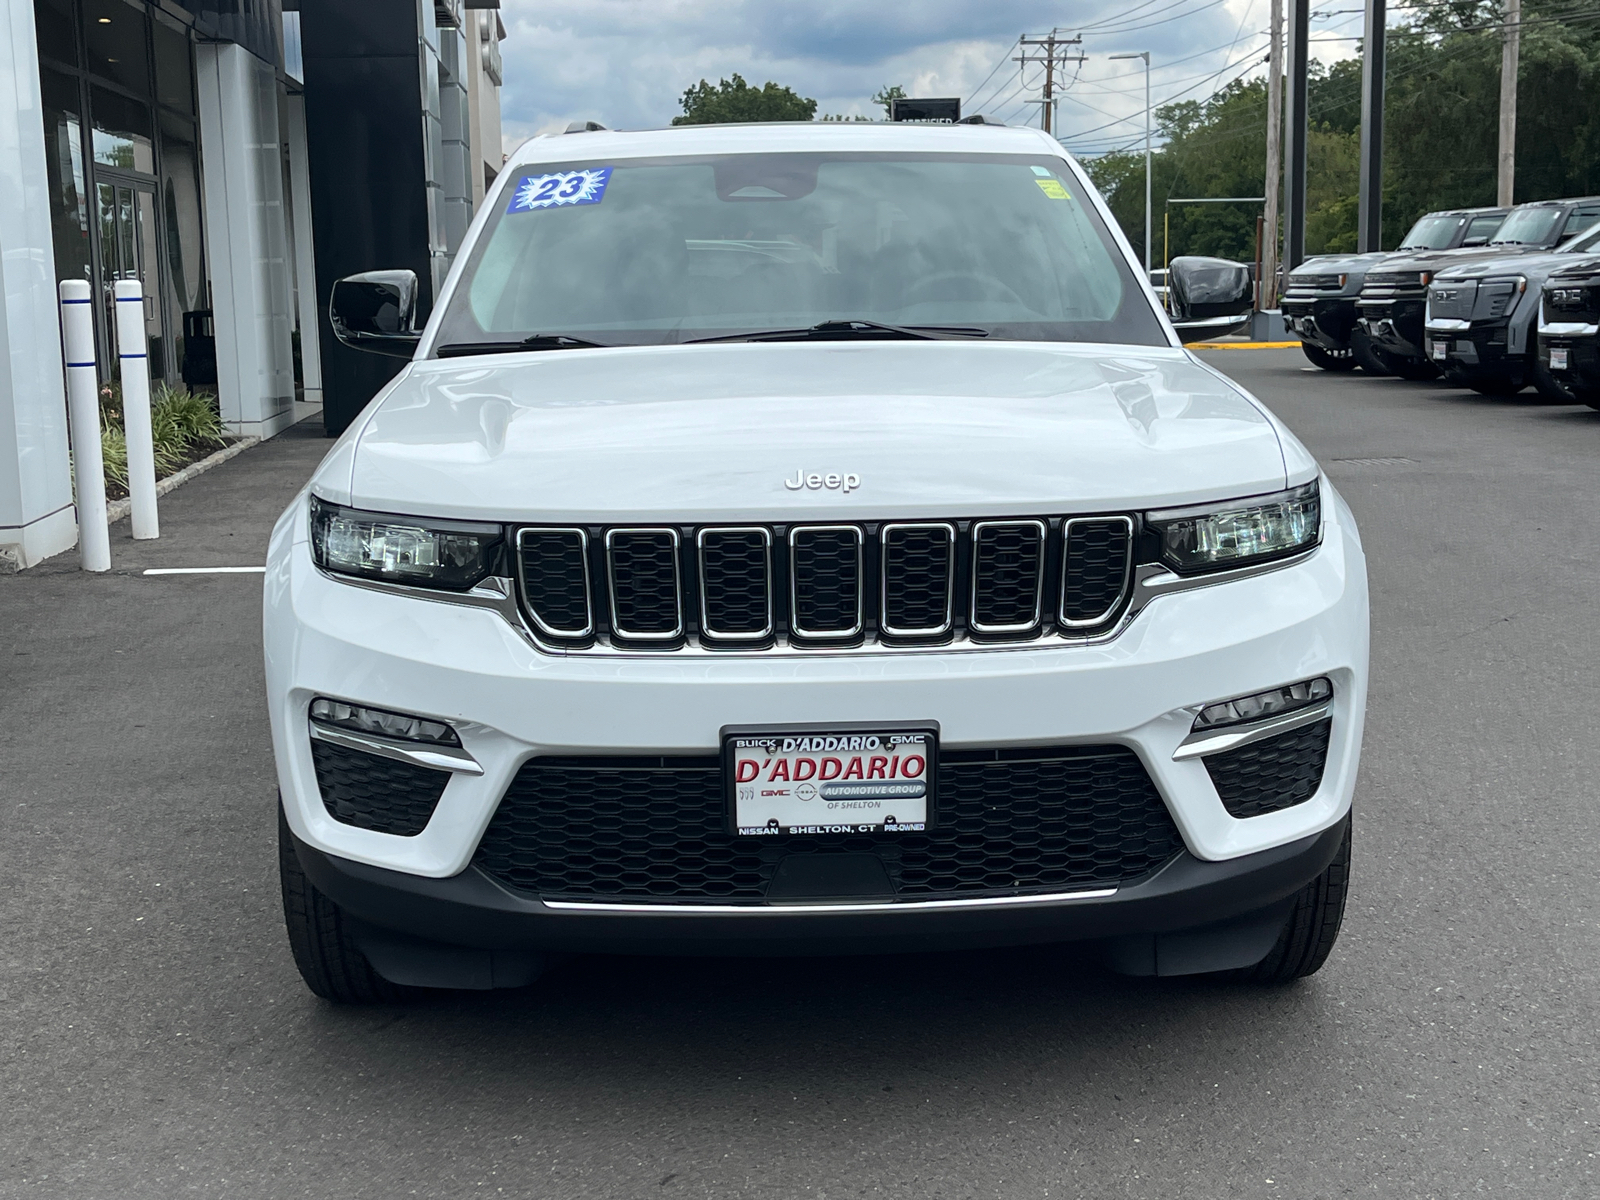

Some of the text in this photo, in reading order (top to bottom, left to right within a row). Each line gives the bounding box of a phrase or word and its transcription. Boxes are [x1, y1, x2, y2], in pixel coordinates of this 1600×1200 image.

[532, 176, 586, 201] 23
[784, 469, 861, 494] Jeep
[736, 735, 925, 753] BUICK D'ADDARIO GMC
[736, 754, 926, 783] D'ADDARIO
[761, 789, 791, 797] GMC
[825, 785, 922, 796] AUTOMOTIVE GROUP
[827, 801, 882, 810] OF SHELTON
[738, 823, 925, 836] NISSAN SHELTON, CT PRE-OWNED
